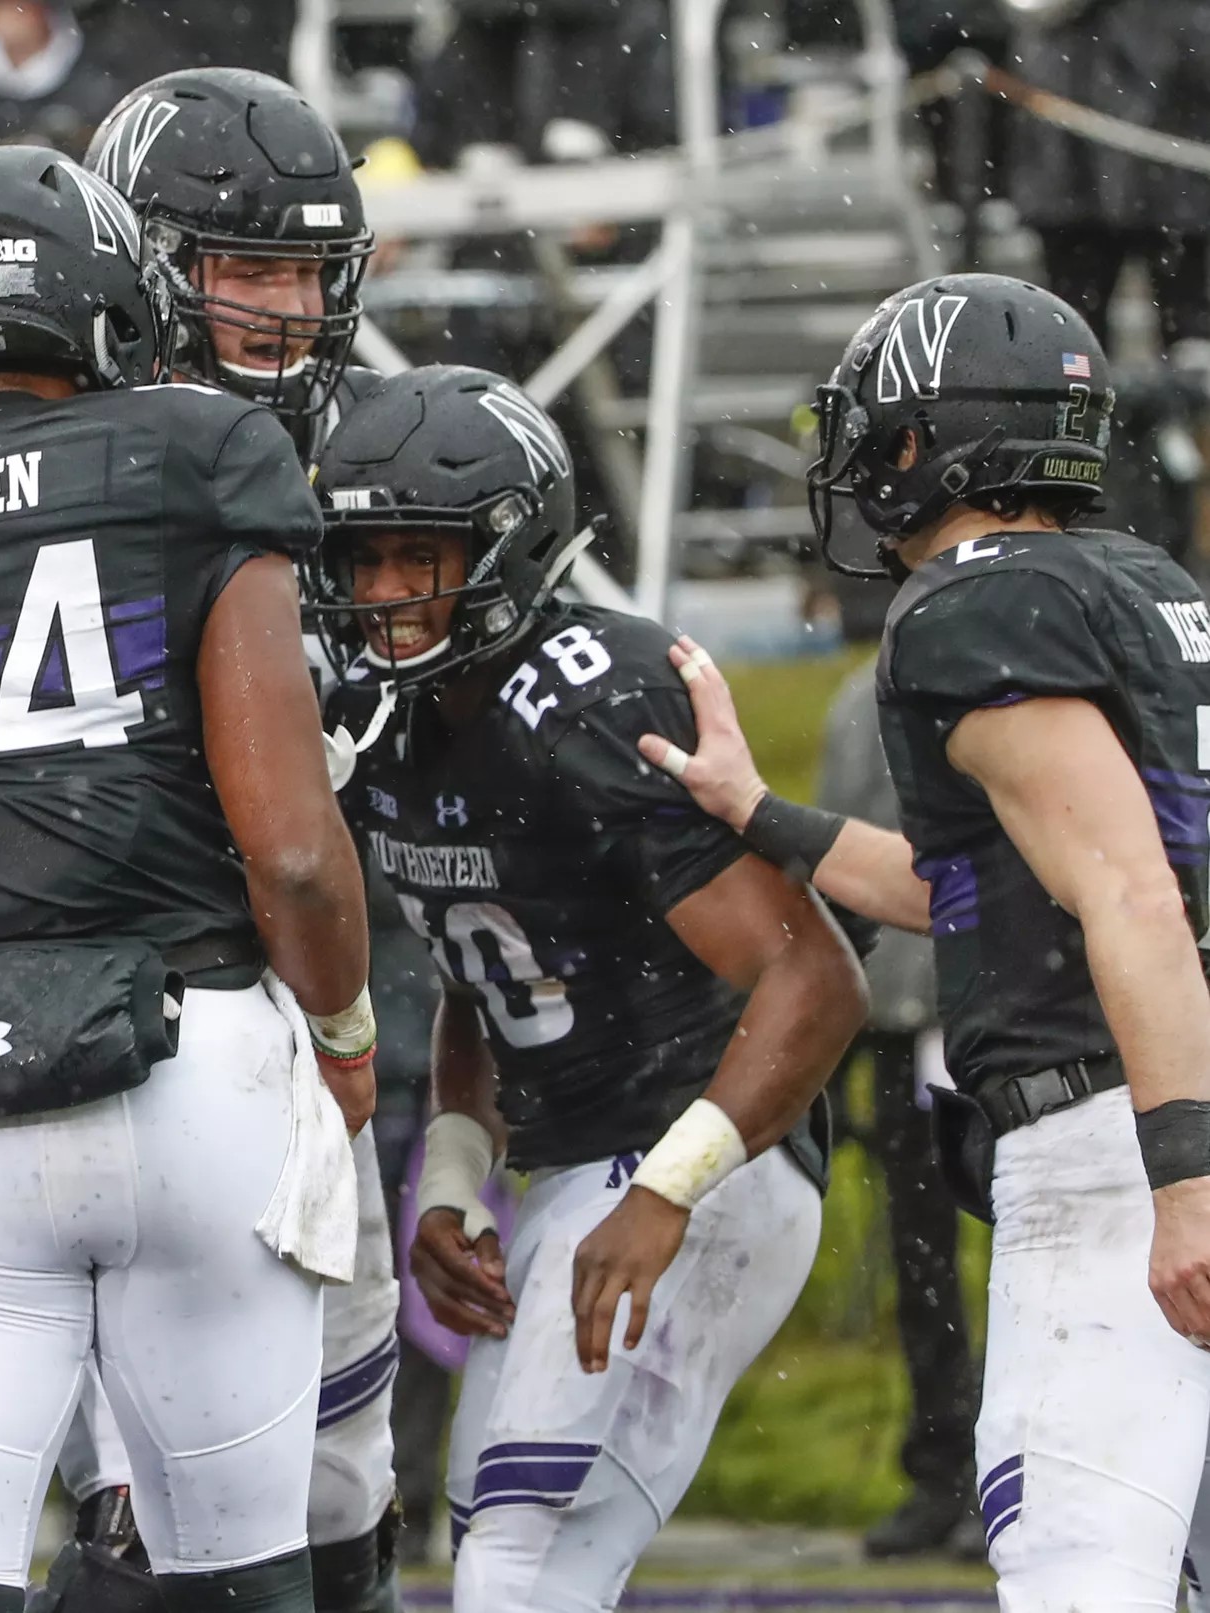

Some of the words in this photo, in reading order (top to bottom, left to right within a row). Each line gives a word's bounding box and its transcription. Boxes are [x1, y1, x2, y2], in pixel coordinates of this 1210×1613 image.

[876, 295, 969, 404] N
[1061, 382, 1091, 440] 2
[1042, 457, 1103, 481] WILDCATS
[498, 624, 612, 731] 28
